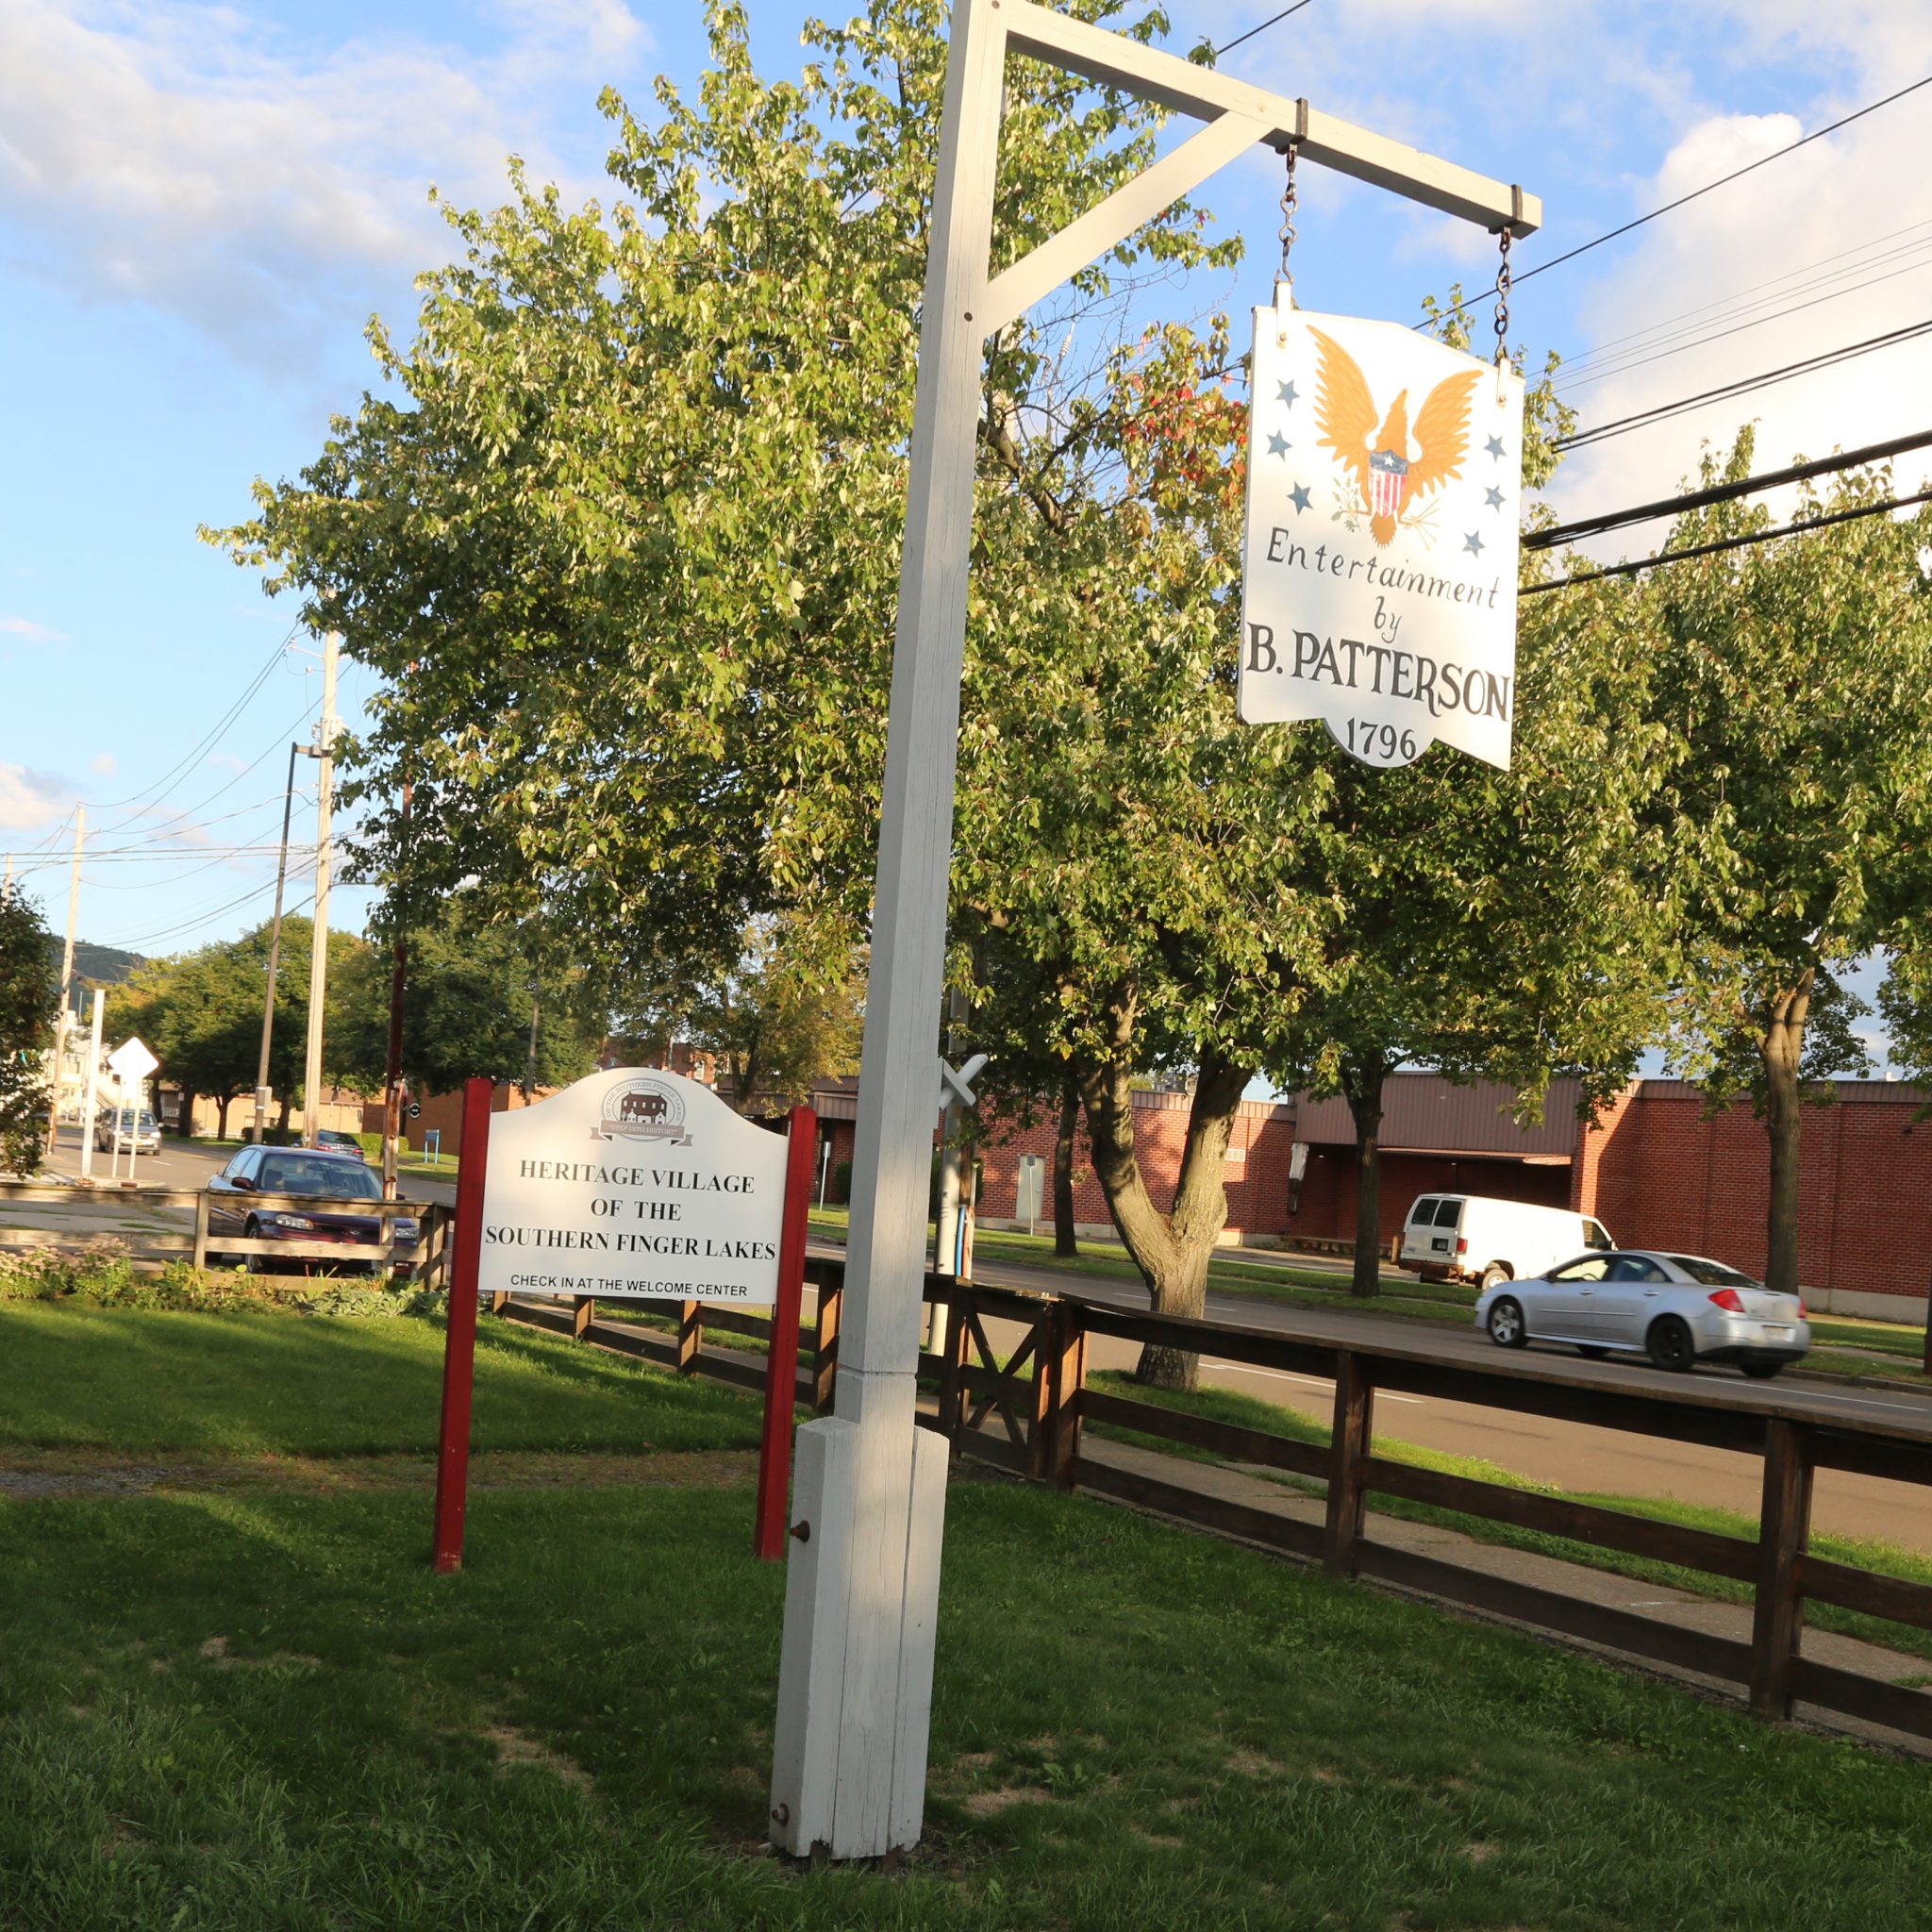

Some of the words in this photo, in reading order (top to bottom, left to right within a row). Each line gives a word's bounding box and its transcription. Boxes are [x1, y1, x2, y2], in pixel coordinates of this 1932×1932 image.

[1267, 527, 1499, 608] Entertainment
[1374, 596, 1402, 643] by
[1245, 622, 1284, 675] B.
[1290, 628, 1510, 722] PATTERSON
[1347, 718, 1416, 760] 1796
[616, 1081, 651, 1094] SOUTHERN
[520, 1159, 644, 1186] HERITAGE
[651, 1169, 756, 1194] VILLAGE
[591, 1198, 624, 1218] OF
[634, 1201, 682, 1222] THE
[485, 1225, 610, 1251] SOUTHERN
[616, 1234, 699, 1257] FINGER
[705, 1239, 775, 1261] LAKES
[510, 1274, 558, 1287] CHECK
[560, 1276, 574, 1289] IN
[576, 1277, 594, 1290] AT
[597, 1278, 624, 1291] THE
[626, 1279, 693, 1294] WELCOME
[696, 1283, 748, 1297] CENTER
